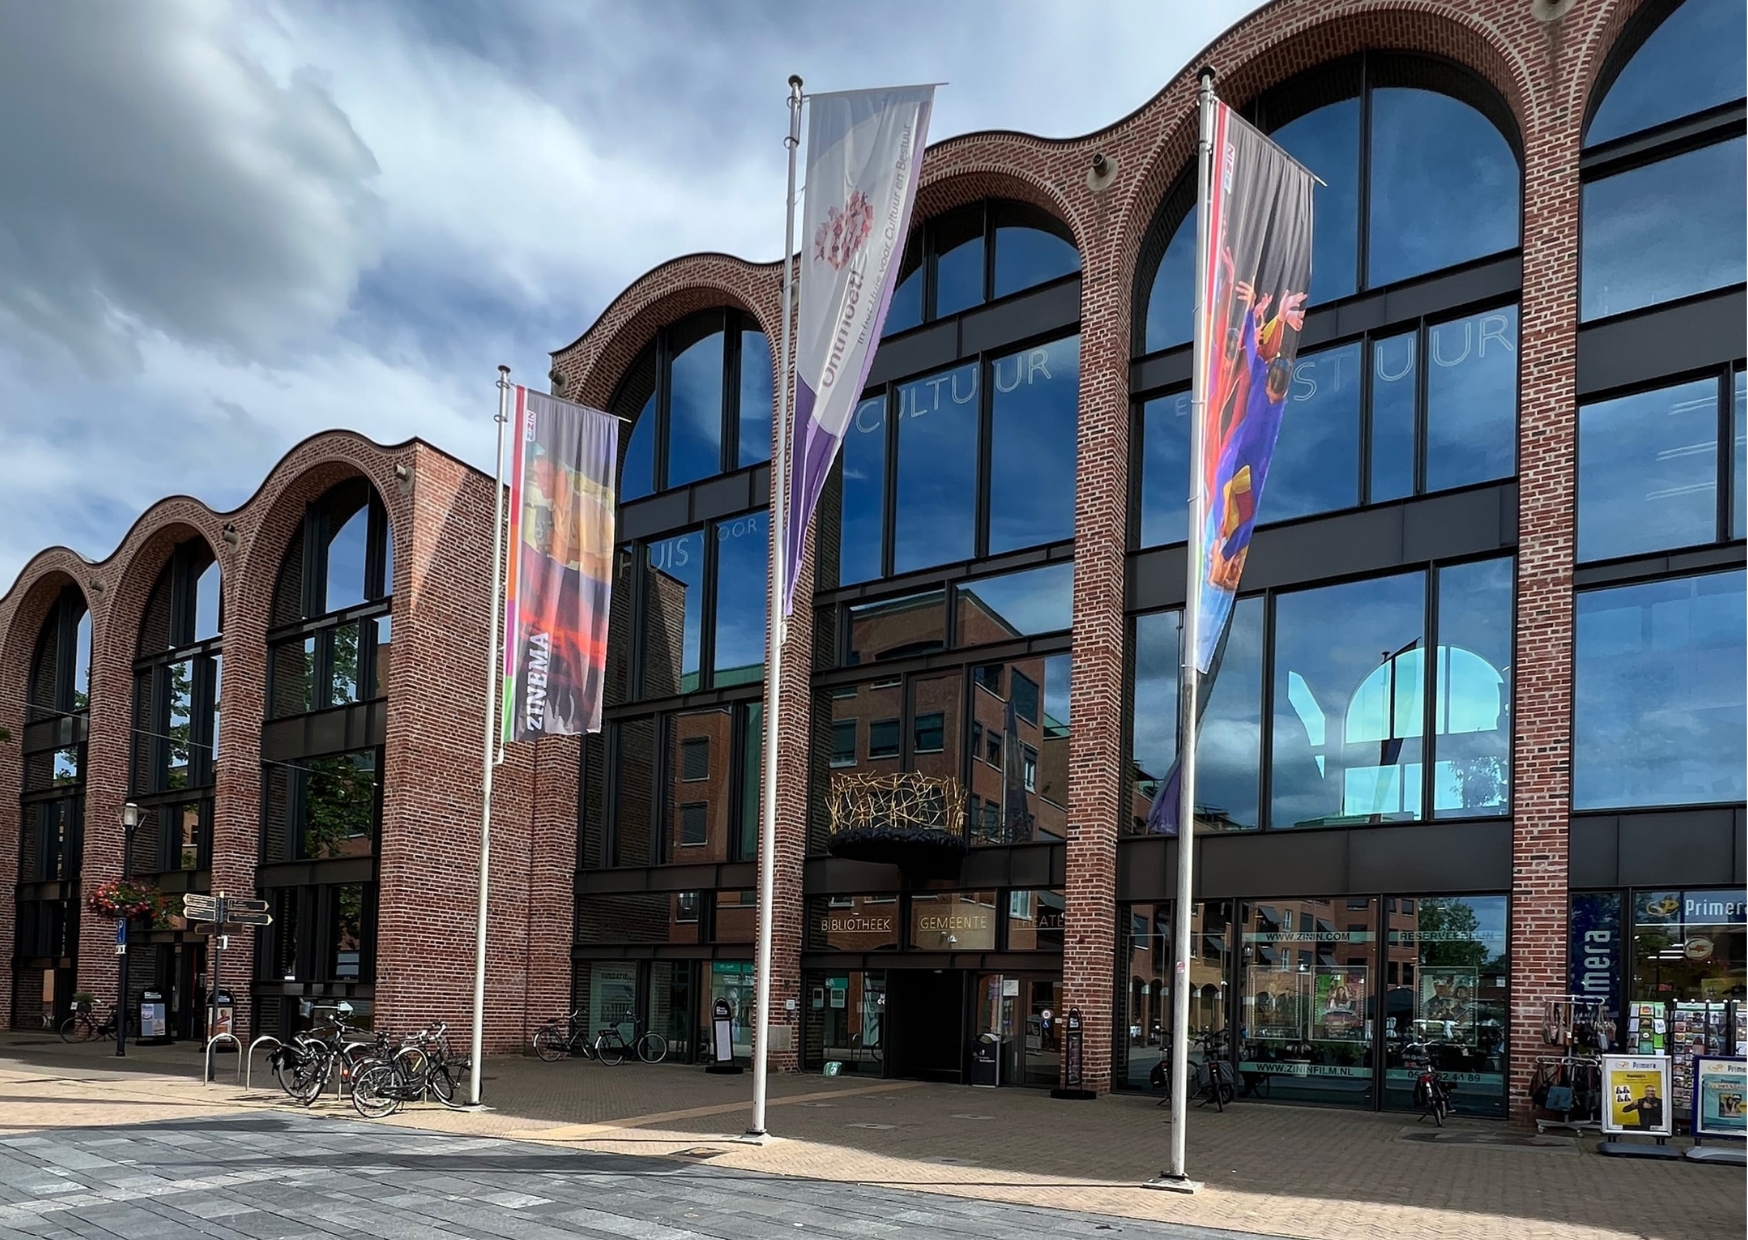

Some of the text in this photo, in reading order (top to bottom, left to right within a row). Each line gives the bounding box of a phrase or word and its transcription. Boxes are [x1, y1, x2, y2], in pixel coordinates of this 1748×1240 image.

[895, 124, 912, 172] Bestuur
[895, 173, 905, 190] en
[884, 192, 902, 240] Cultuur
[879, 242, 892, 273] voor
[822, 270, 865, 388] Ontmoet!
[855, 350, 1052, 434] CULTUUR
[526, 631, 549, 732] ZINEMA
[821, 917, 891, 931] BIBLIOTHEEK
[920, 916, 987, 929] GEMEENTE
[1266, 932, 1350, 942] WWW.ZININ.COM
[1256, 1062, 1354, 1077] WWW.ZININFILM.NL
[1632, 1061, 1657, 1069] Primera
[1467, 1073, 1481, 1083] 89
